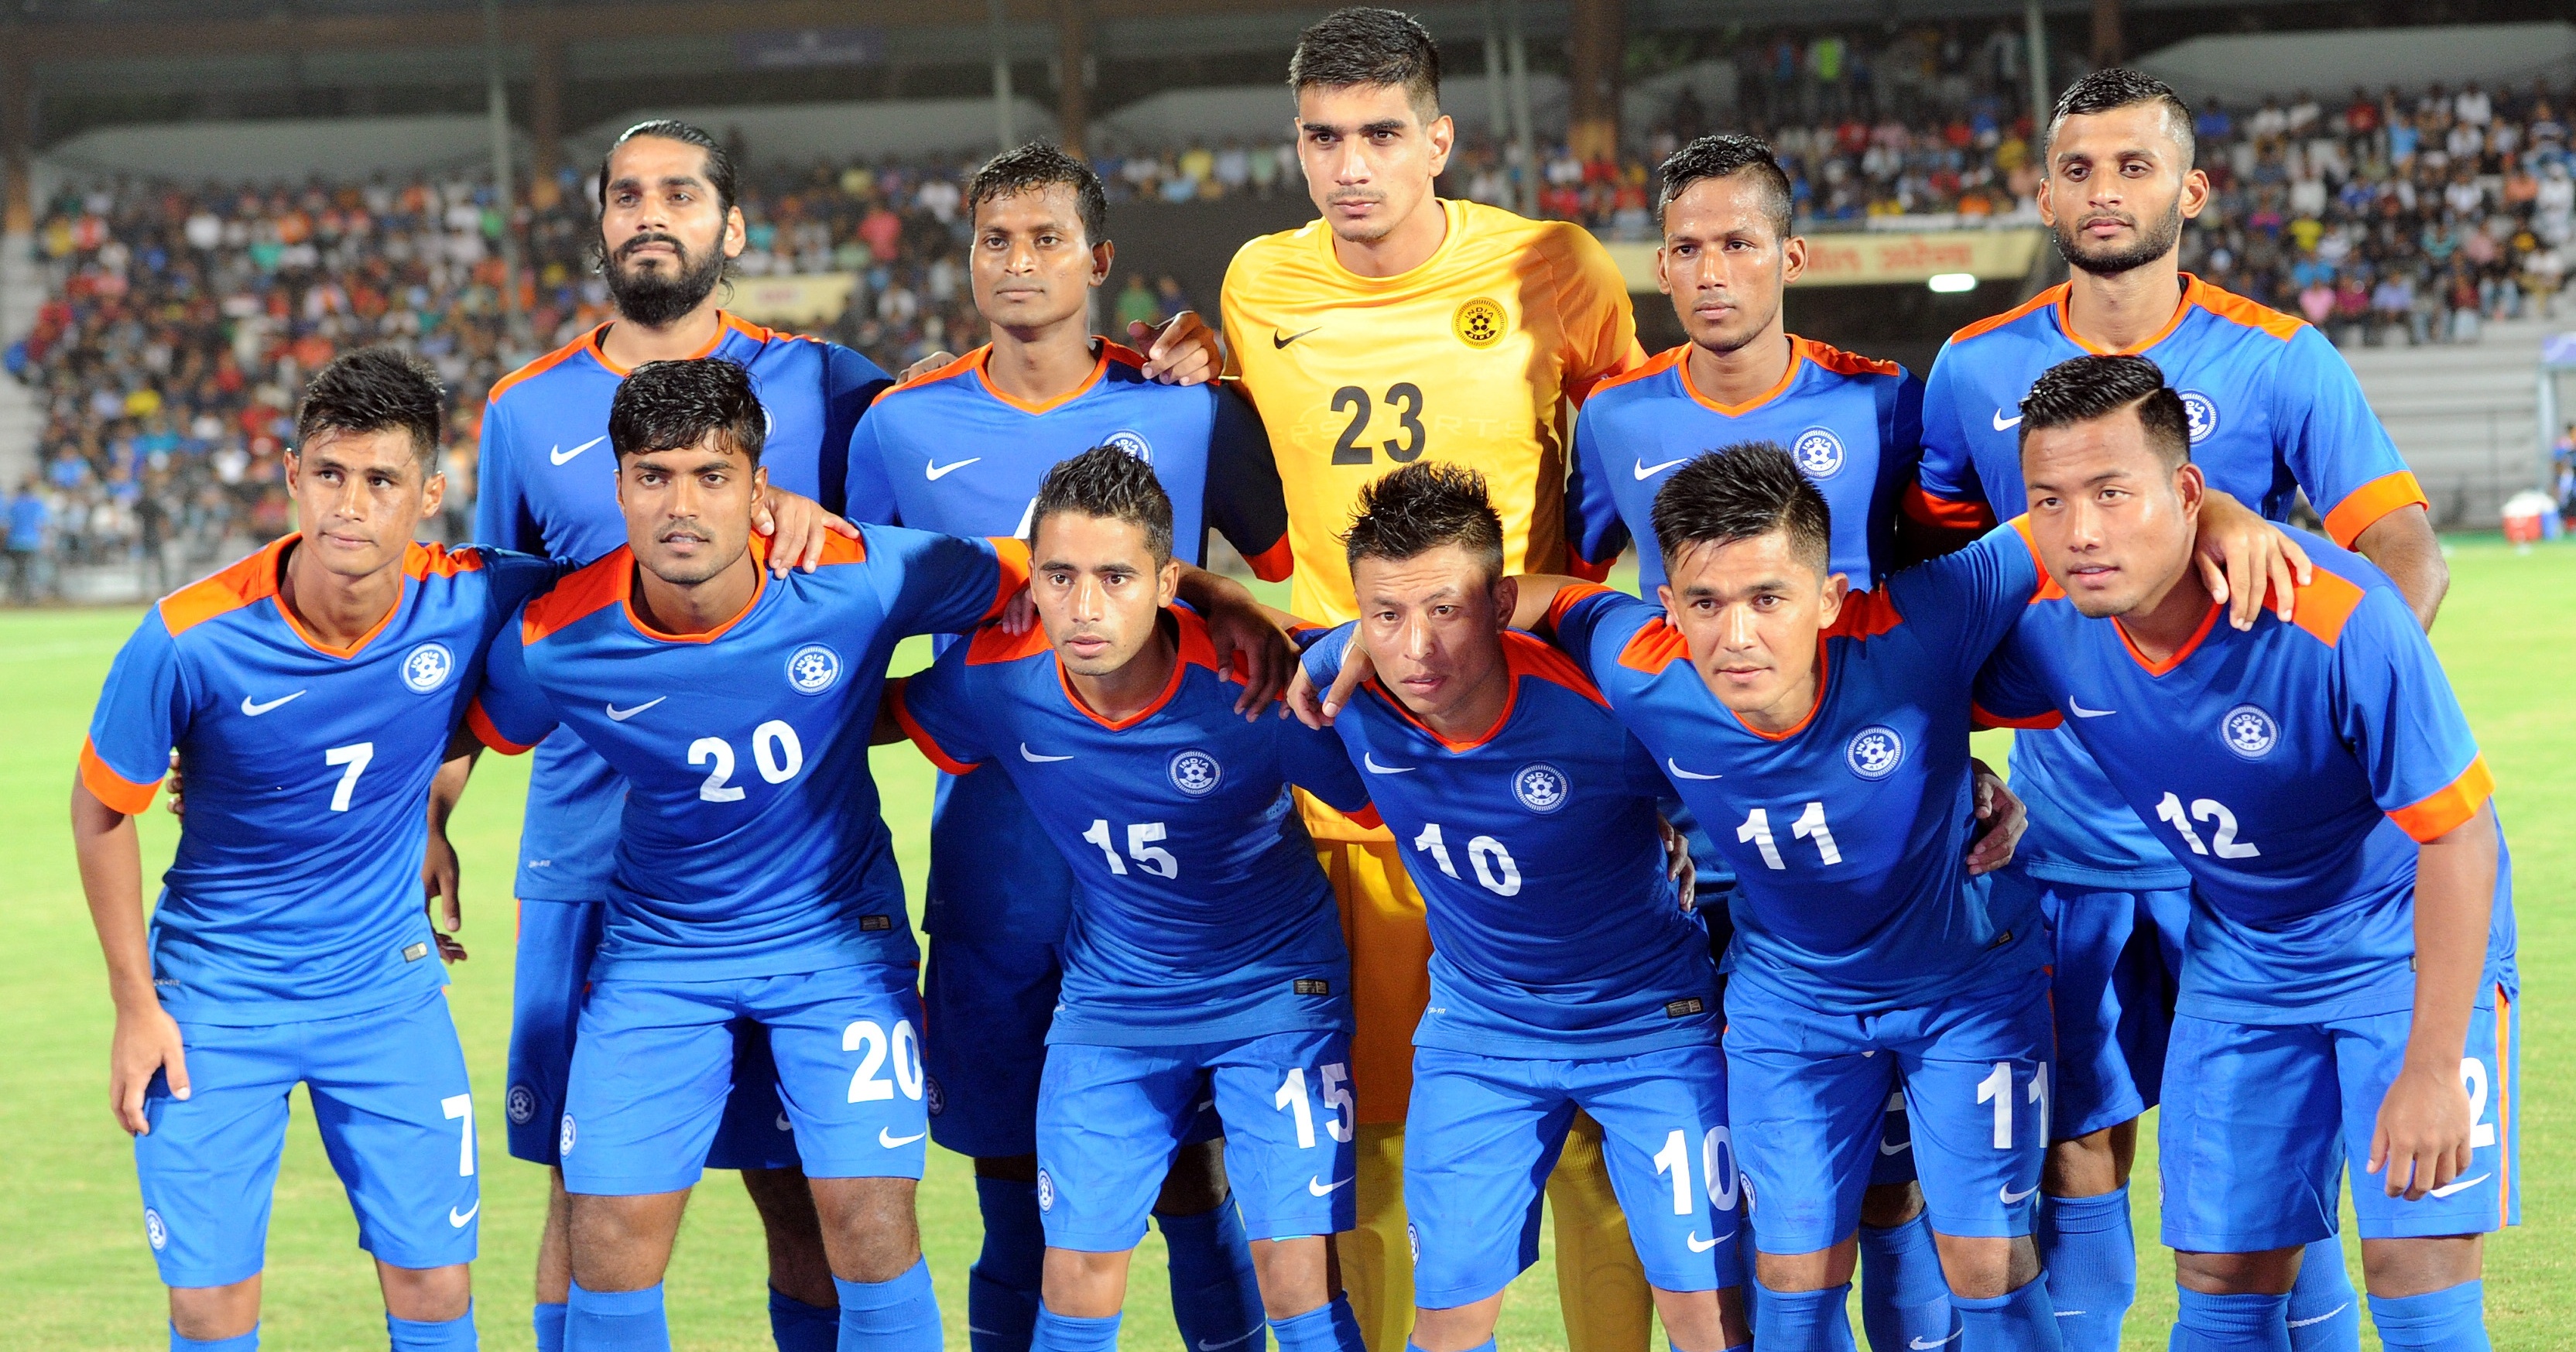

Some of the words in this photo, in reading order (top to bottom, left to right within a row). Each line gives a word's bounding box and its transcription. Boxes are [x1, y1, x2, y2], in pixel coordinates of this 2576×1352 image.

[1464, 306, 1494, 319] INDIA
[1330, 382, 1426, 466] 23
[1802, 436, 1832, 450] INDIA
[794, 653, 825, 671] INDIA
[1855, 734, 1885, 755] INDIA
[2230, 714, 2263, 728] INDIA
[326, 741, 374, 812] 7
[687, 719, 803, 803] 20
[1178, 758, 1209, 769] INDIA
[1523, 772, 1556, 784] INDIA
[1081, 819, 1178, 880] 15
[1735, 802, 1843, 870] 11
[2155, 791, 2261, 859] 12
[1413, 823, 1522, 897] 10
[841, 1019, 924, 1104] 20
[440, 1093, 474, 1177] 7
[1274, 1063, 1354, 1149] 15
[1977, 1061, 2050, 1148] 11
[1653, 1125, 1738, 1216] 10
